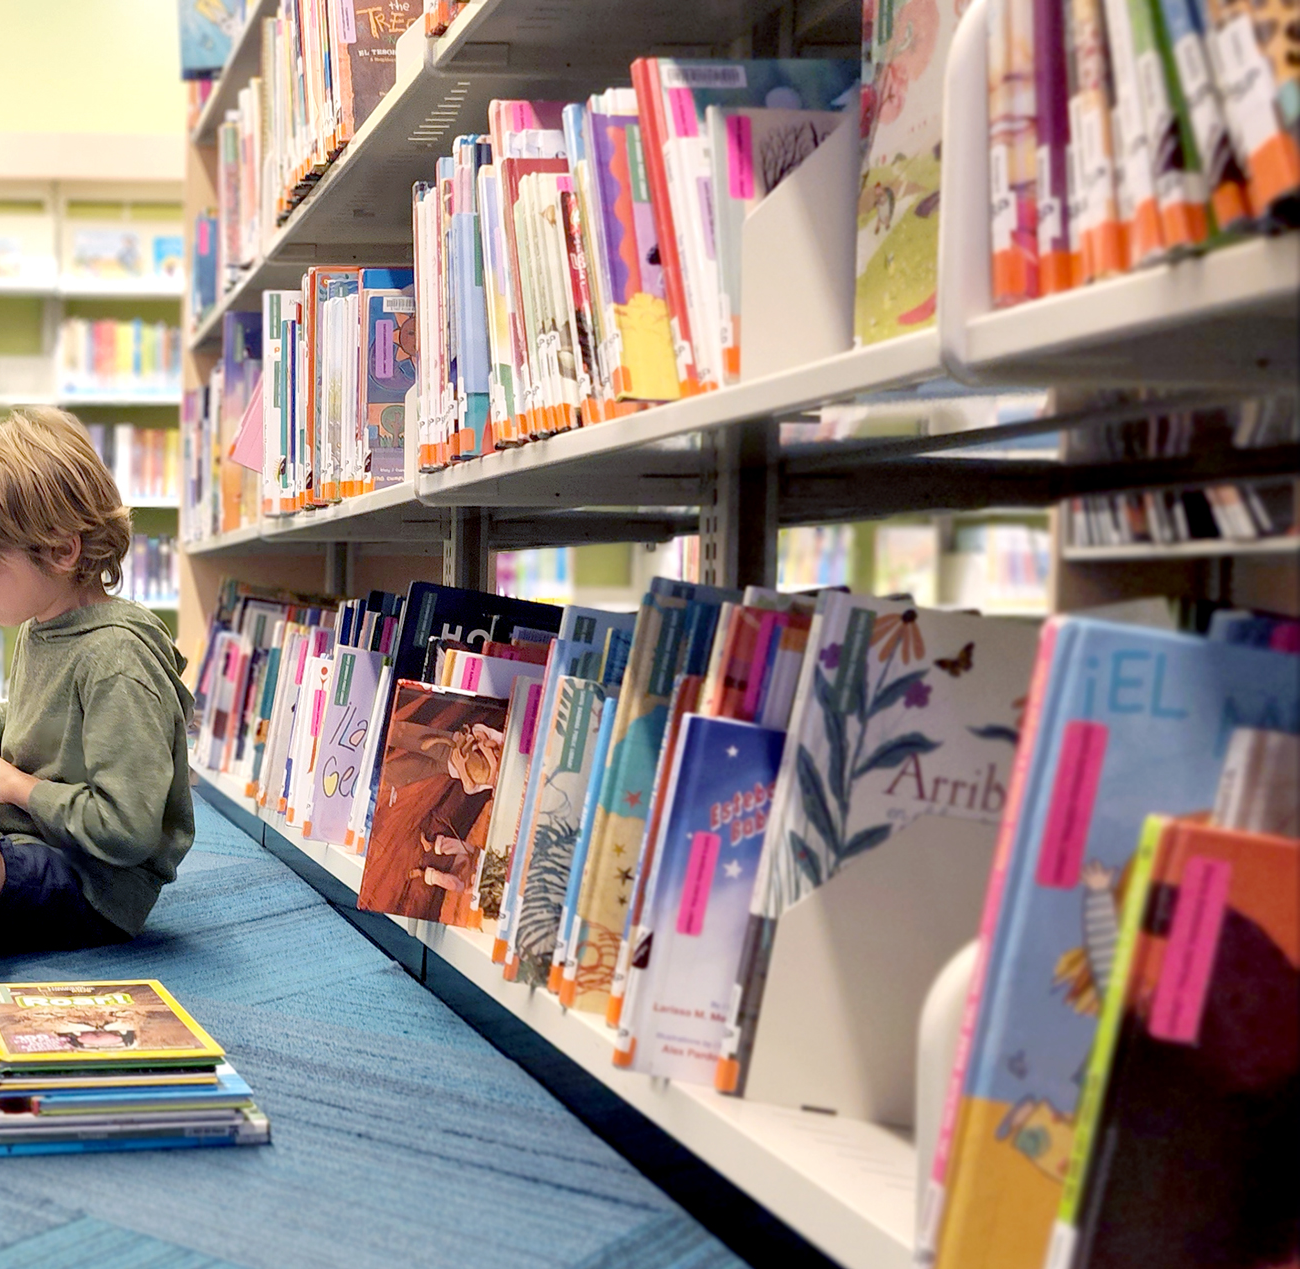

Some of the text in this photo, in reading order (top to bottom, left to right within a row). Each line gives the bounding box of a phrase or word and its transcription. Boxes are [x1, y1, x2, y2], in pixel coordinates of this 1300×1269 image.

[388, 0, 411, 11] the
[731, 808, 770, 847] Bab
[22, 993, 129, 1007] Roar!
